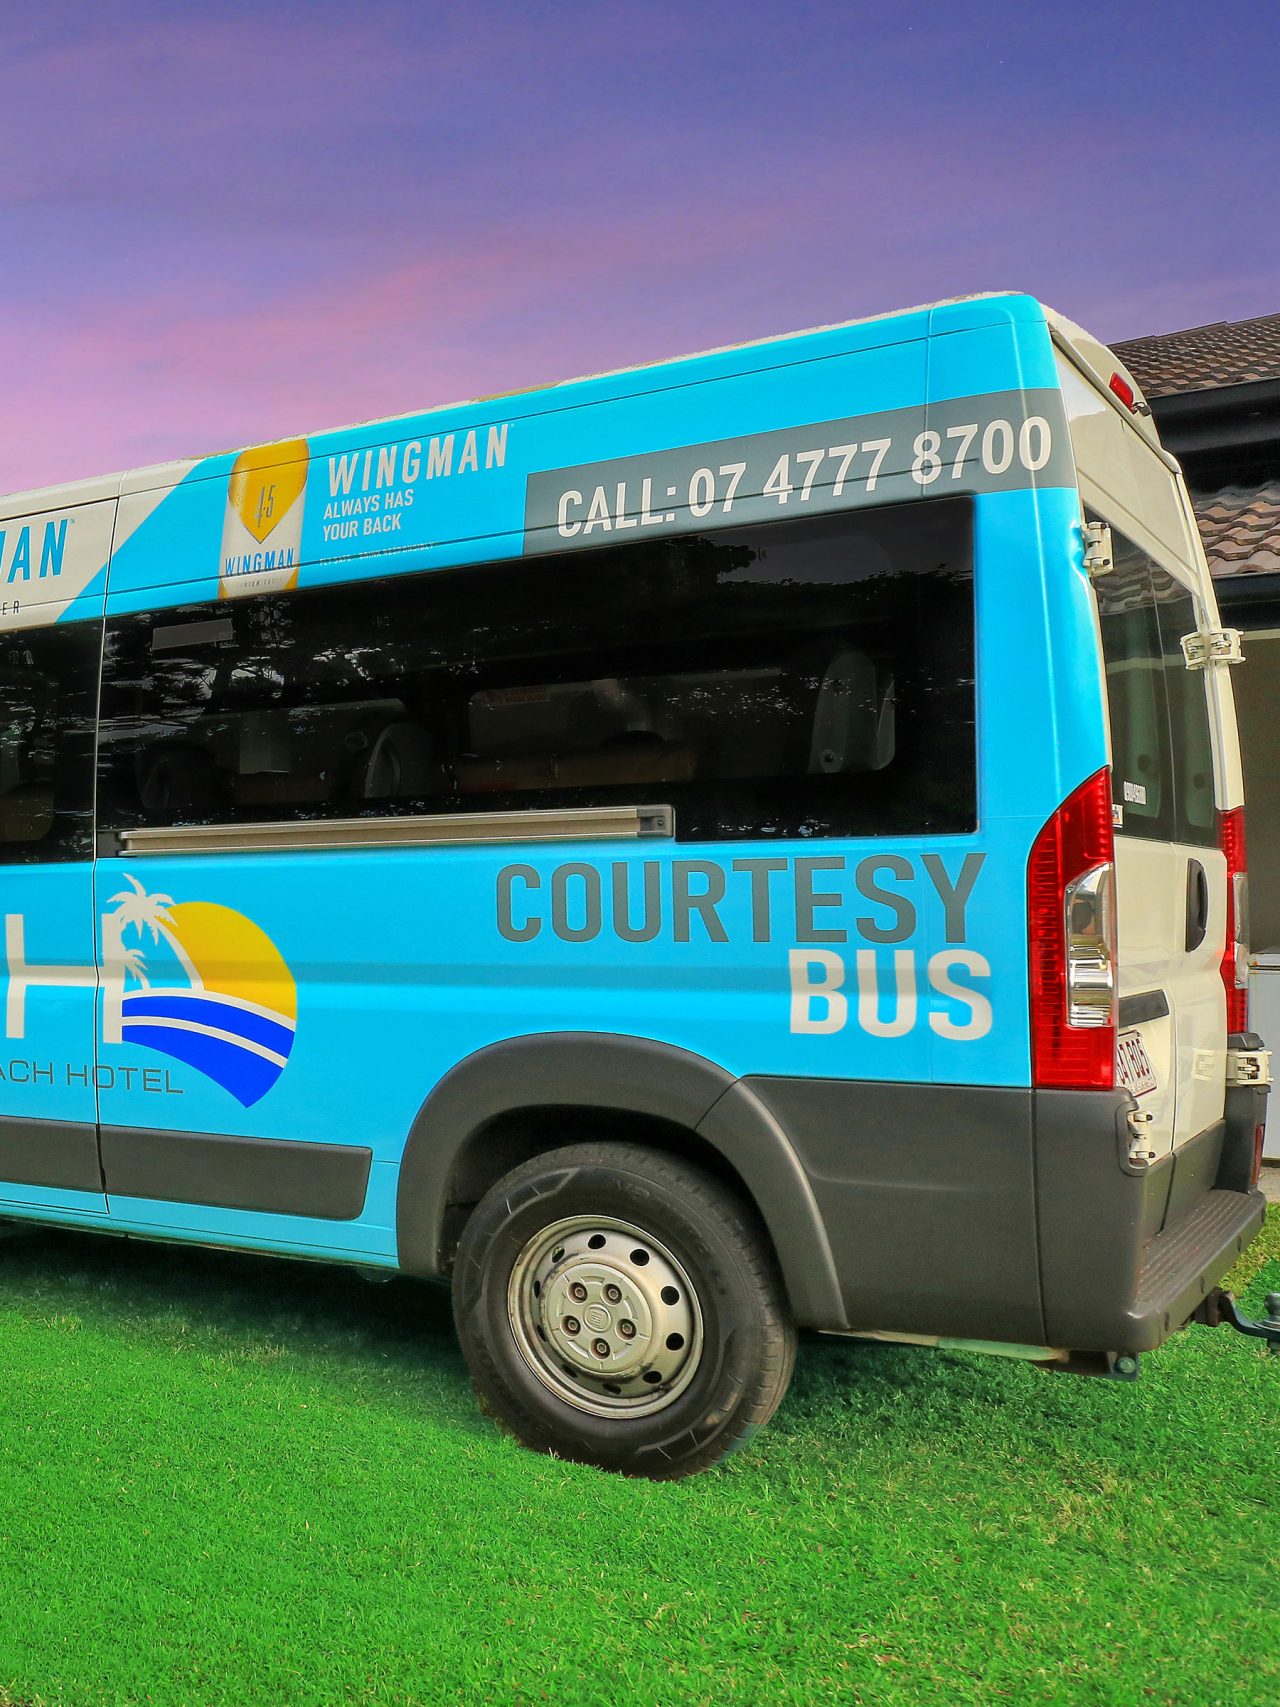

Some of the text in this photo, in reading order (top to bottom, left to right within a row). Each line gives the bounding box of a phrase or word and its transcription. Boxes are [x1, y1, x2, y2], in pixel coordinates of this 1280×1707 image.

[328, 423, 509, 497] WINGMAN
[557, 416, 1052, 538] CALL: 07 4777 8700
[323, 488, 415, 520] ALWAYS HAS
[323, 512, 402, 542] YOUR BACK
[225, 547, 295, 577] WINGMAN
[496, 852, 987, 945] COURTESY
[788, 948, 994, 1042] BUS
[66, 1062, 185, 1095] HOTEL
